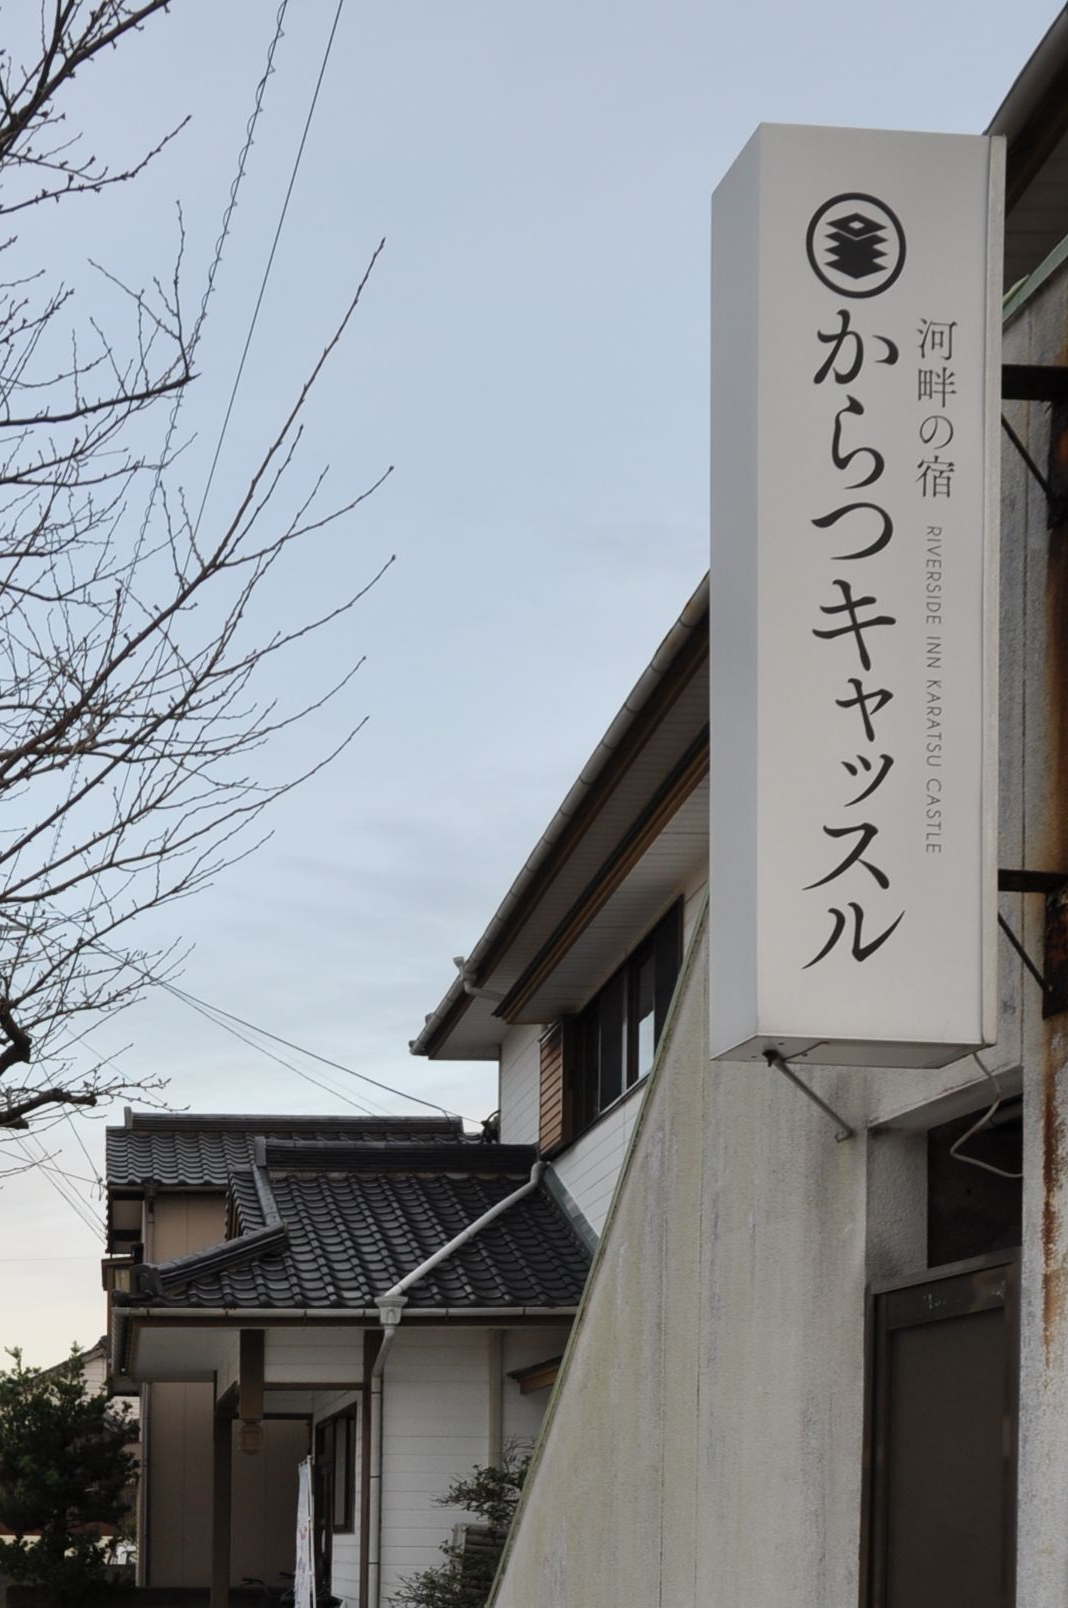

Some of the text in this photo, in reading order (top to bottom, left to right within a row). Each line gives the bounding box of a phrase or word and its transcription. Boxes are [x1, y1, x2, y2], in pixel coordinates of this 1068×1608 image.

[915, 317, 958, 499] 河畔の宿
[802, 308, 905, 970] からつキャッスル
[925, 525, 943, 853] RIVERSIDE INN KARATSU CASTLE
